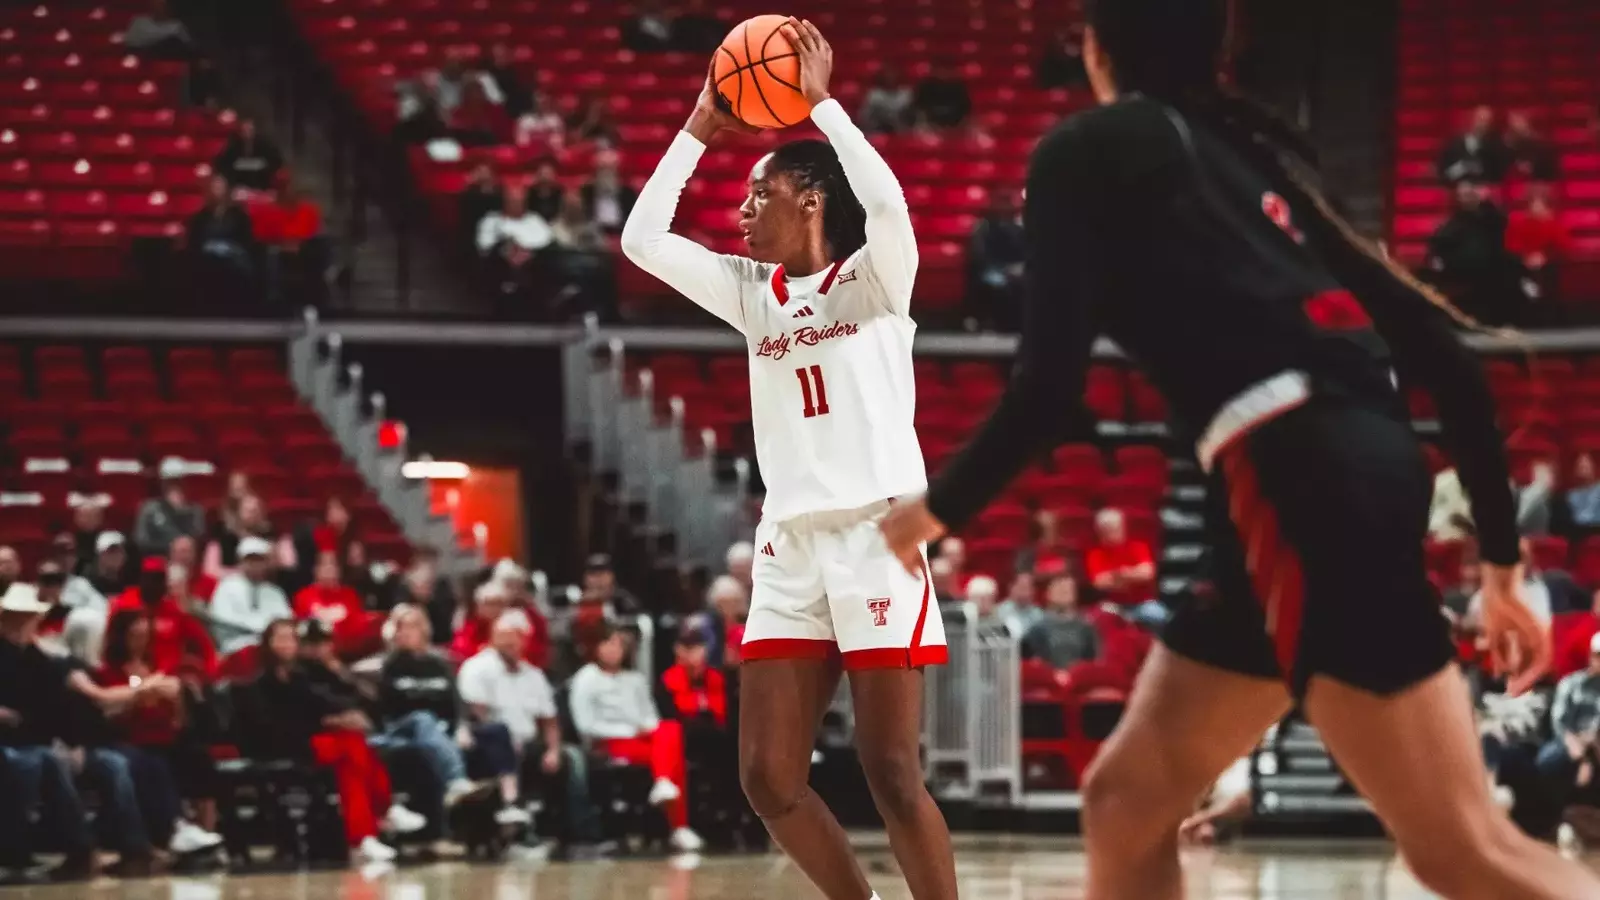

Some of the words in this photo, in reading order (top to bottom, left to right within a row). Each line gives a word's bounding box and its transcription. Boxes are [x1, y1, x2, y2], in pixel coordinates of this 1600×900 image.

[756, 332, 790, 360] Lady
[793, 321, 858, 346] Raiders
[795, 365, 829, 418] 11
